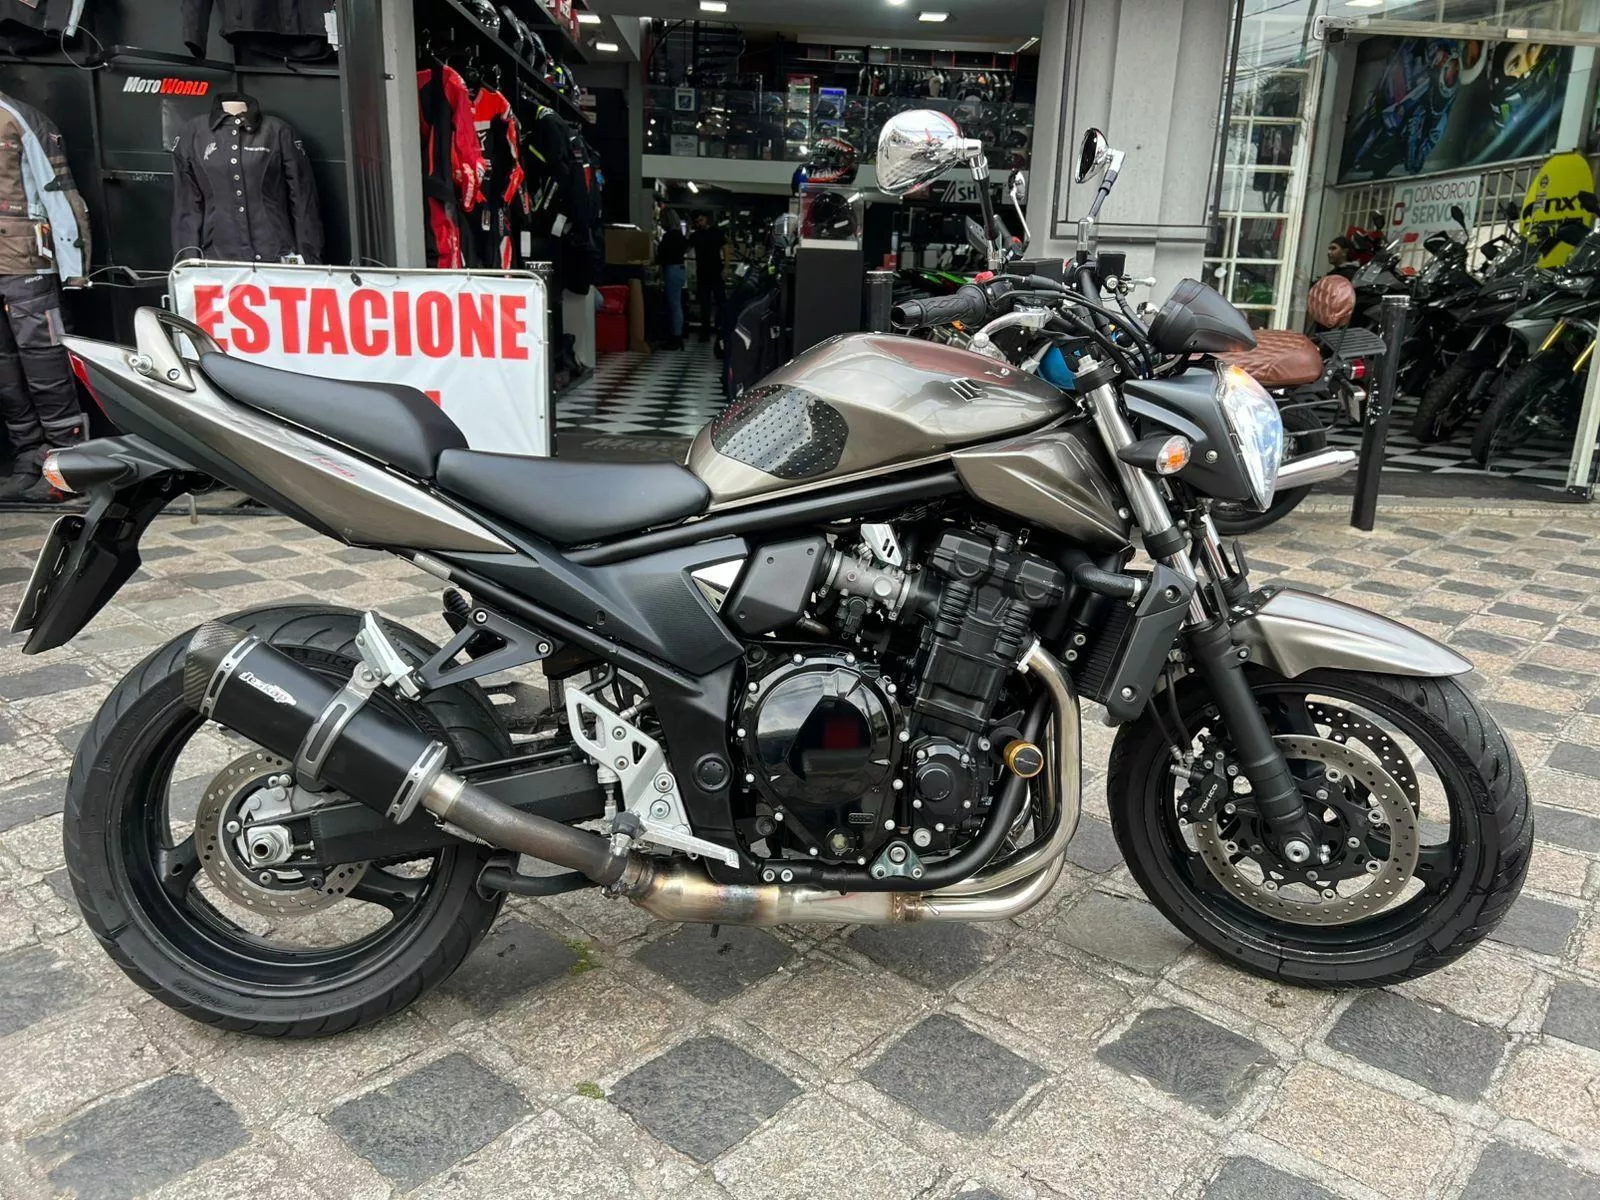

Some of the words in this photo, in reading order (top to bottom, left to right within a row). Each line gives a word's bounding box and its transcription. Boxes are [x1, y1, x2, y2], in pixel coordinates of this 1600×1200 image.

[1415, 180, 1477, 203] CONSORCIO
[1411, 200, 1472, 224] SERVOA
[193, 284, 529, 360] ESTACIONE
[1198, 783, 1218, 814] TOKICO
